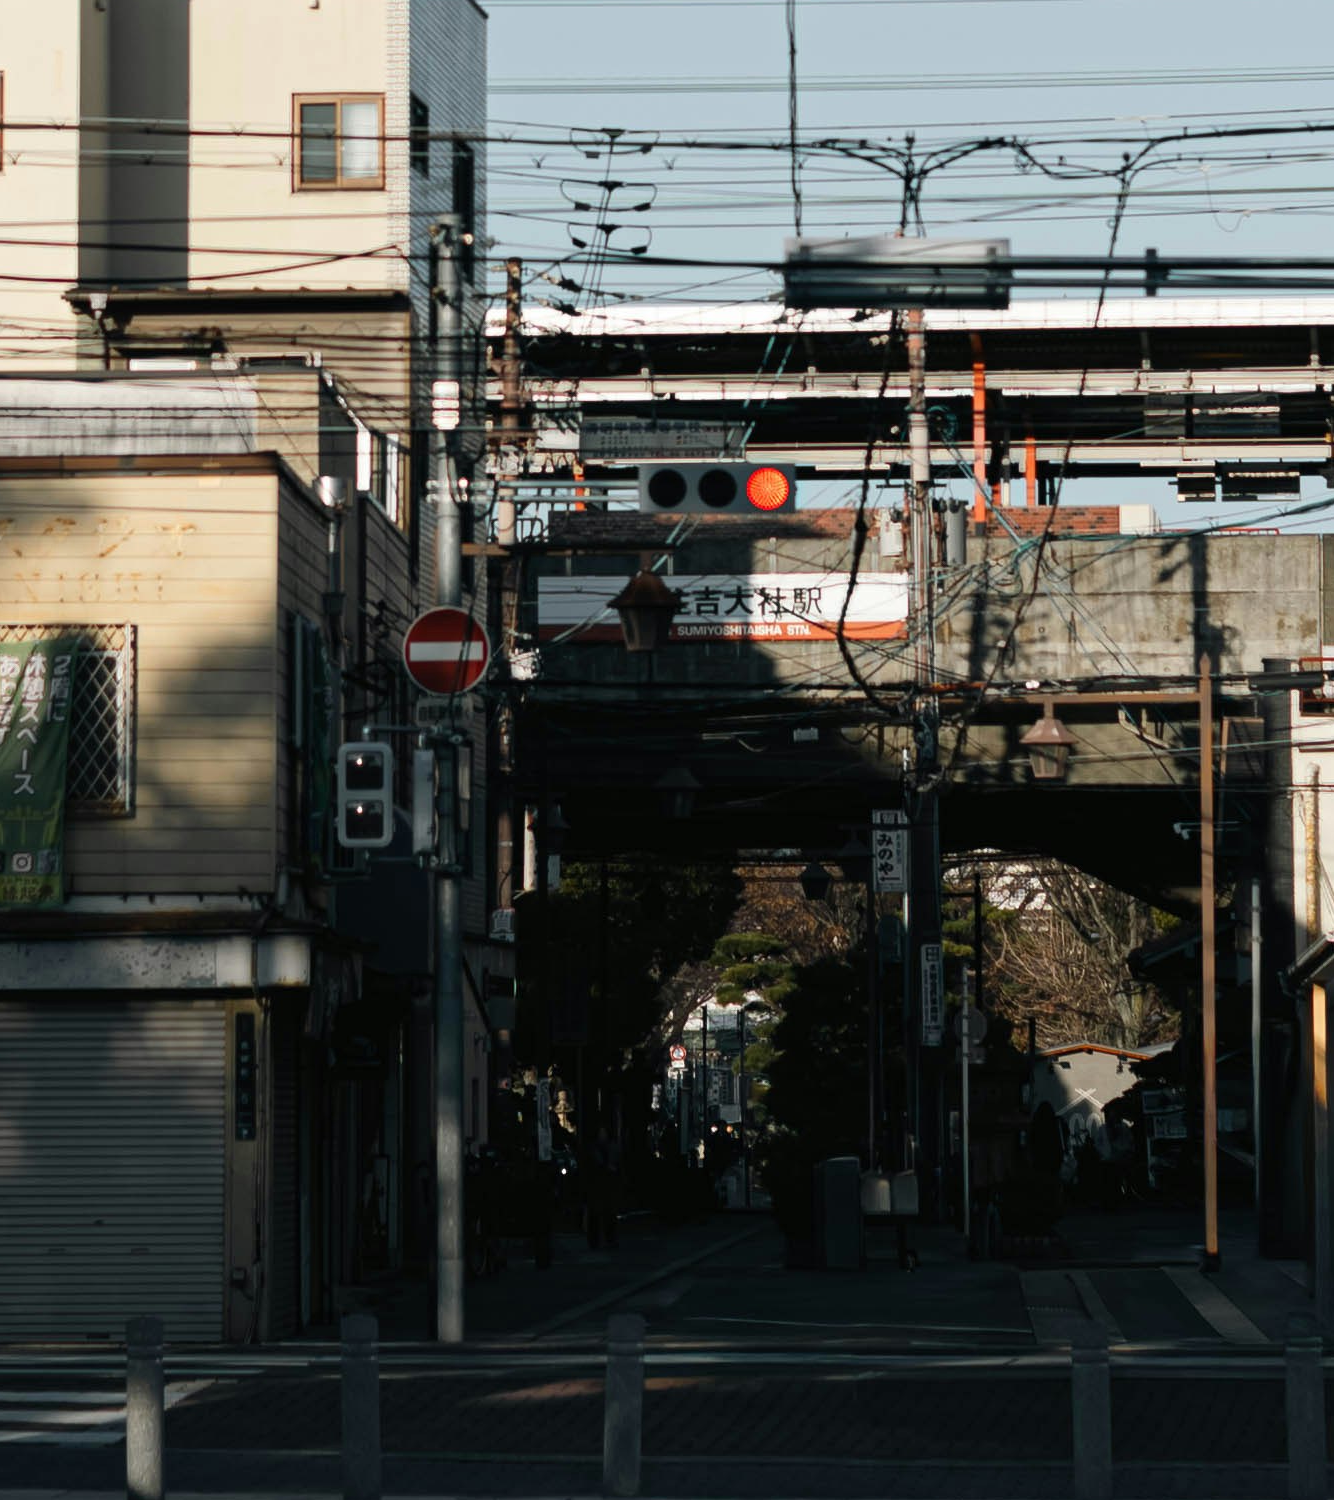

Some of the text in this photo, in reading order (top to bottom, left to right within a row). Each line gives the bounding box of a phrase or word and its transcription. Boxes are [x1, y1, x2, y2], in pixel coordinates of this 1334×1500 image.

[677, 625, 812, 636] SUMIYOSHITAISHA STN.
[46, 654, 72, 722] 2階に
[877, 832, 894, 876] みのや
